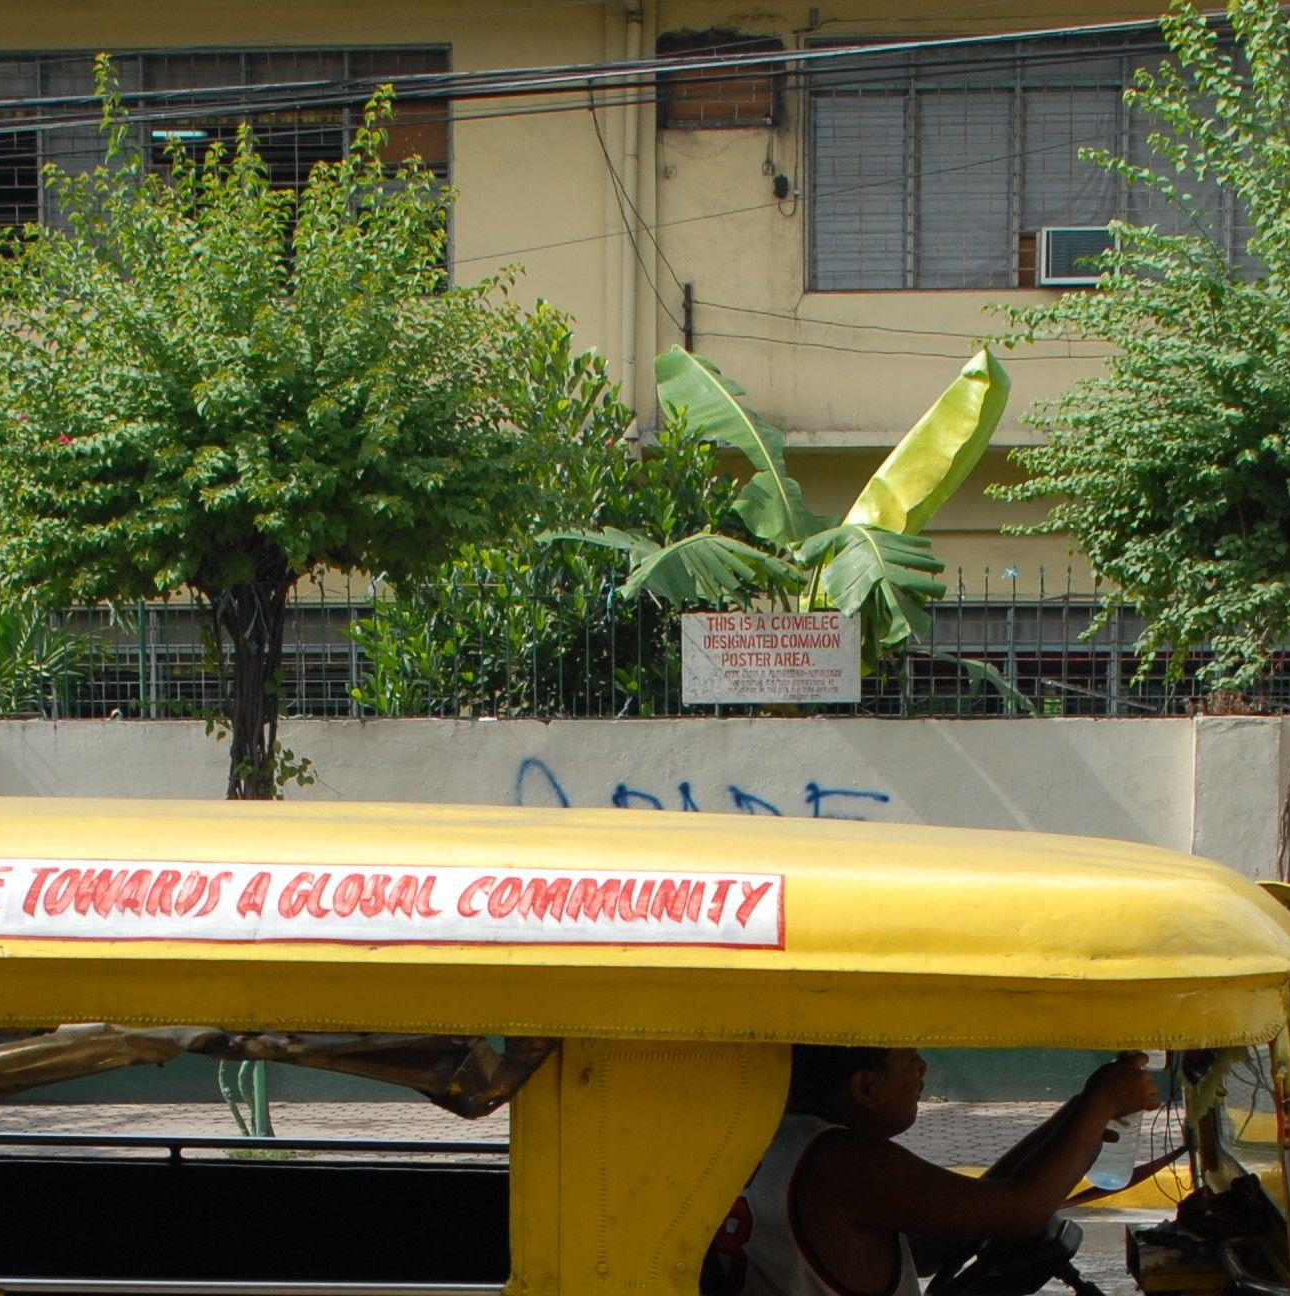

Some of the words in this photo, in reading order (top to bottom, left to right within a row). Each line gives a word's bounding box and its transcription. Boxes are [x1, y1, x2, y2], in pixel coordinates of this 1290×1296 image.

[707, 616, 735, 632] THIS
[740, 616, 752, 631] IS
[756, 616, 766, 631] A
[771, 615, 839, 631] COMELEC
[703, 634, 779, 650] DESIGNATED
[780, 634, 840, 649] COMMON
[721, 652, 771, 667] POSTER
[774, 652, 815, 667] AREA.
[20, 866, 233, 919] TOWARDS
[236, 870, 272, 919] A
[279, 871, 444, 920] GLOBAL
[456, 875, 776, 930] COMMUNITY
